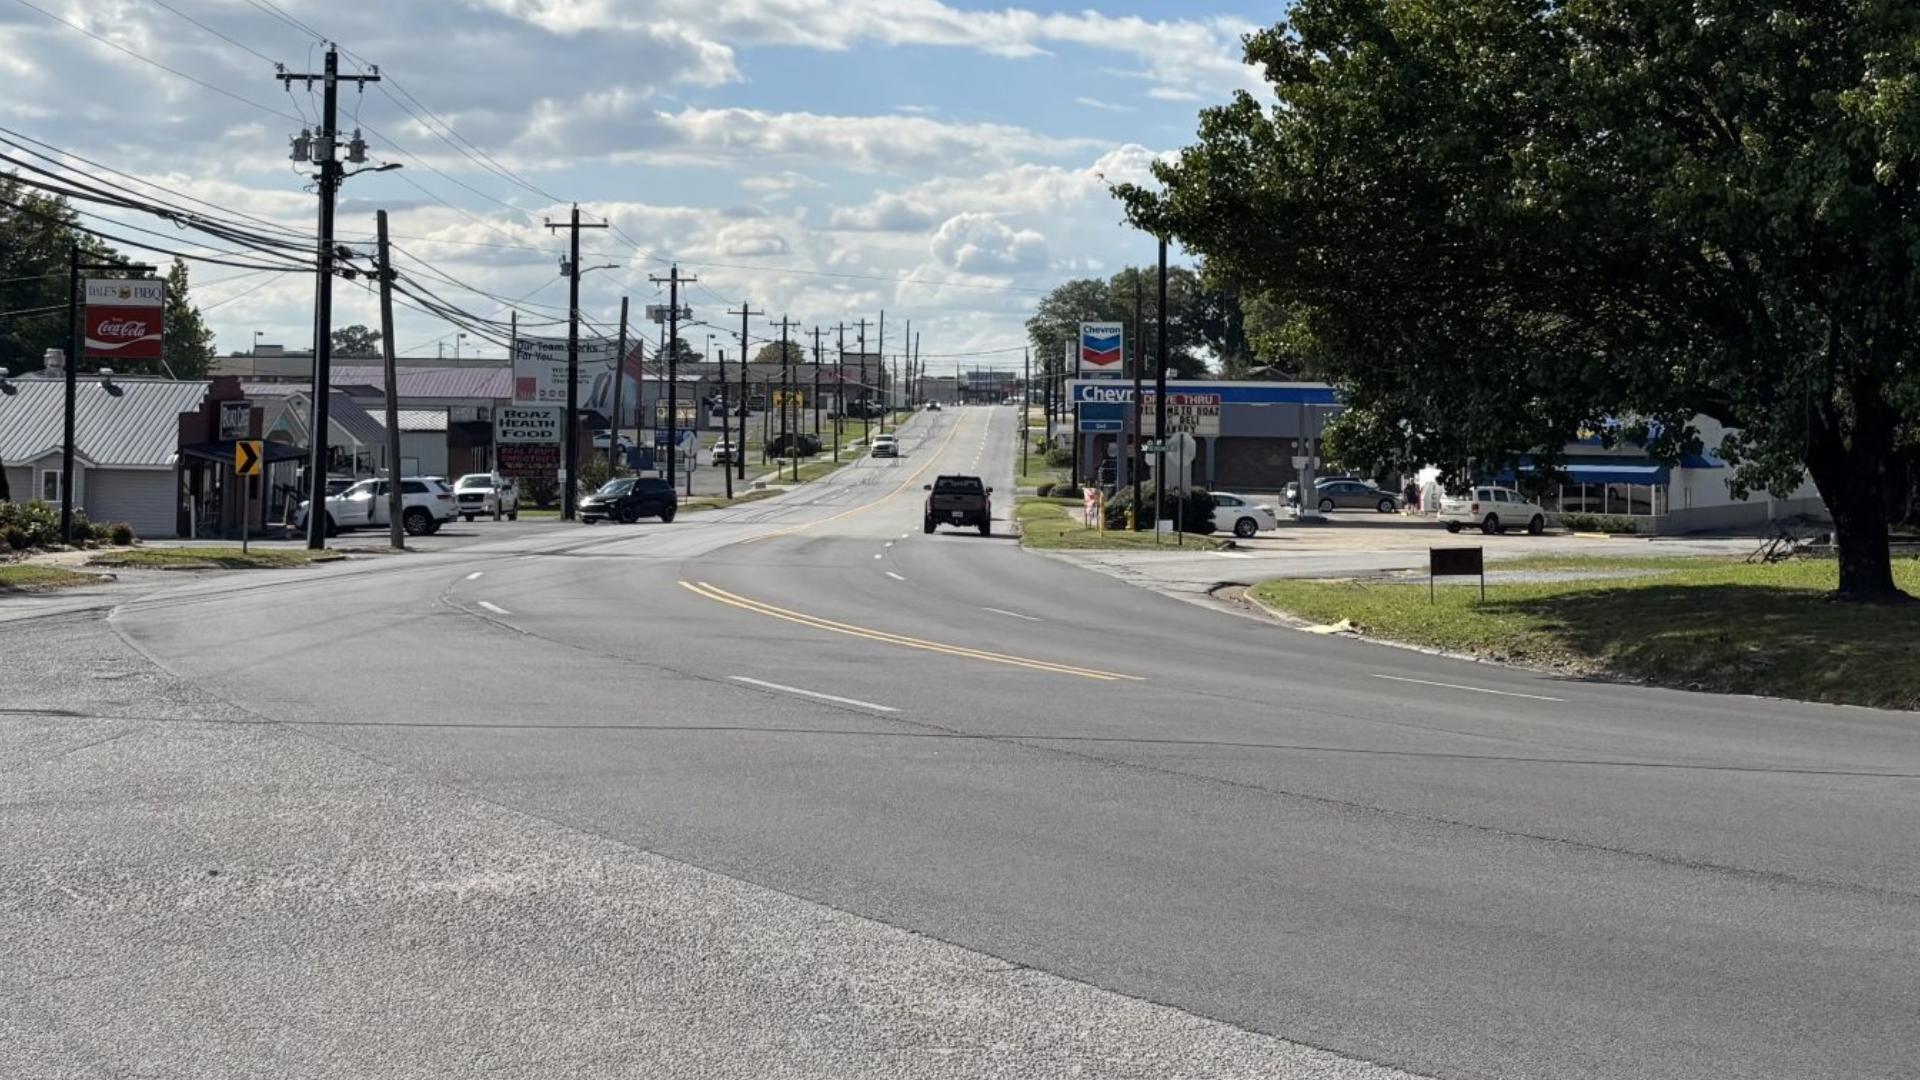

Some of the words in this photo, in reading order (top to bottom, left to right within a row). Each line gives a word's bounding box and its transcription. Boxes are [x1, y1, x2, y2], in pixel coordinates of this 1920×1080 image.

[134, 287, 161, 300] BBQ
[1084, 325, 1120, 334] Chevron
[539, 341, 564, 351] Team
[536, 352, 553, 361] You
[1184, 395, 1214, 405] THRU
[504, 410, 551, 418] BOAZ
[499, 419, 554, 428] HEALTH
[1180, 416, 1199, 425] DELI
[502, 430, 552, 438] FOOD
